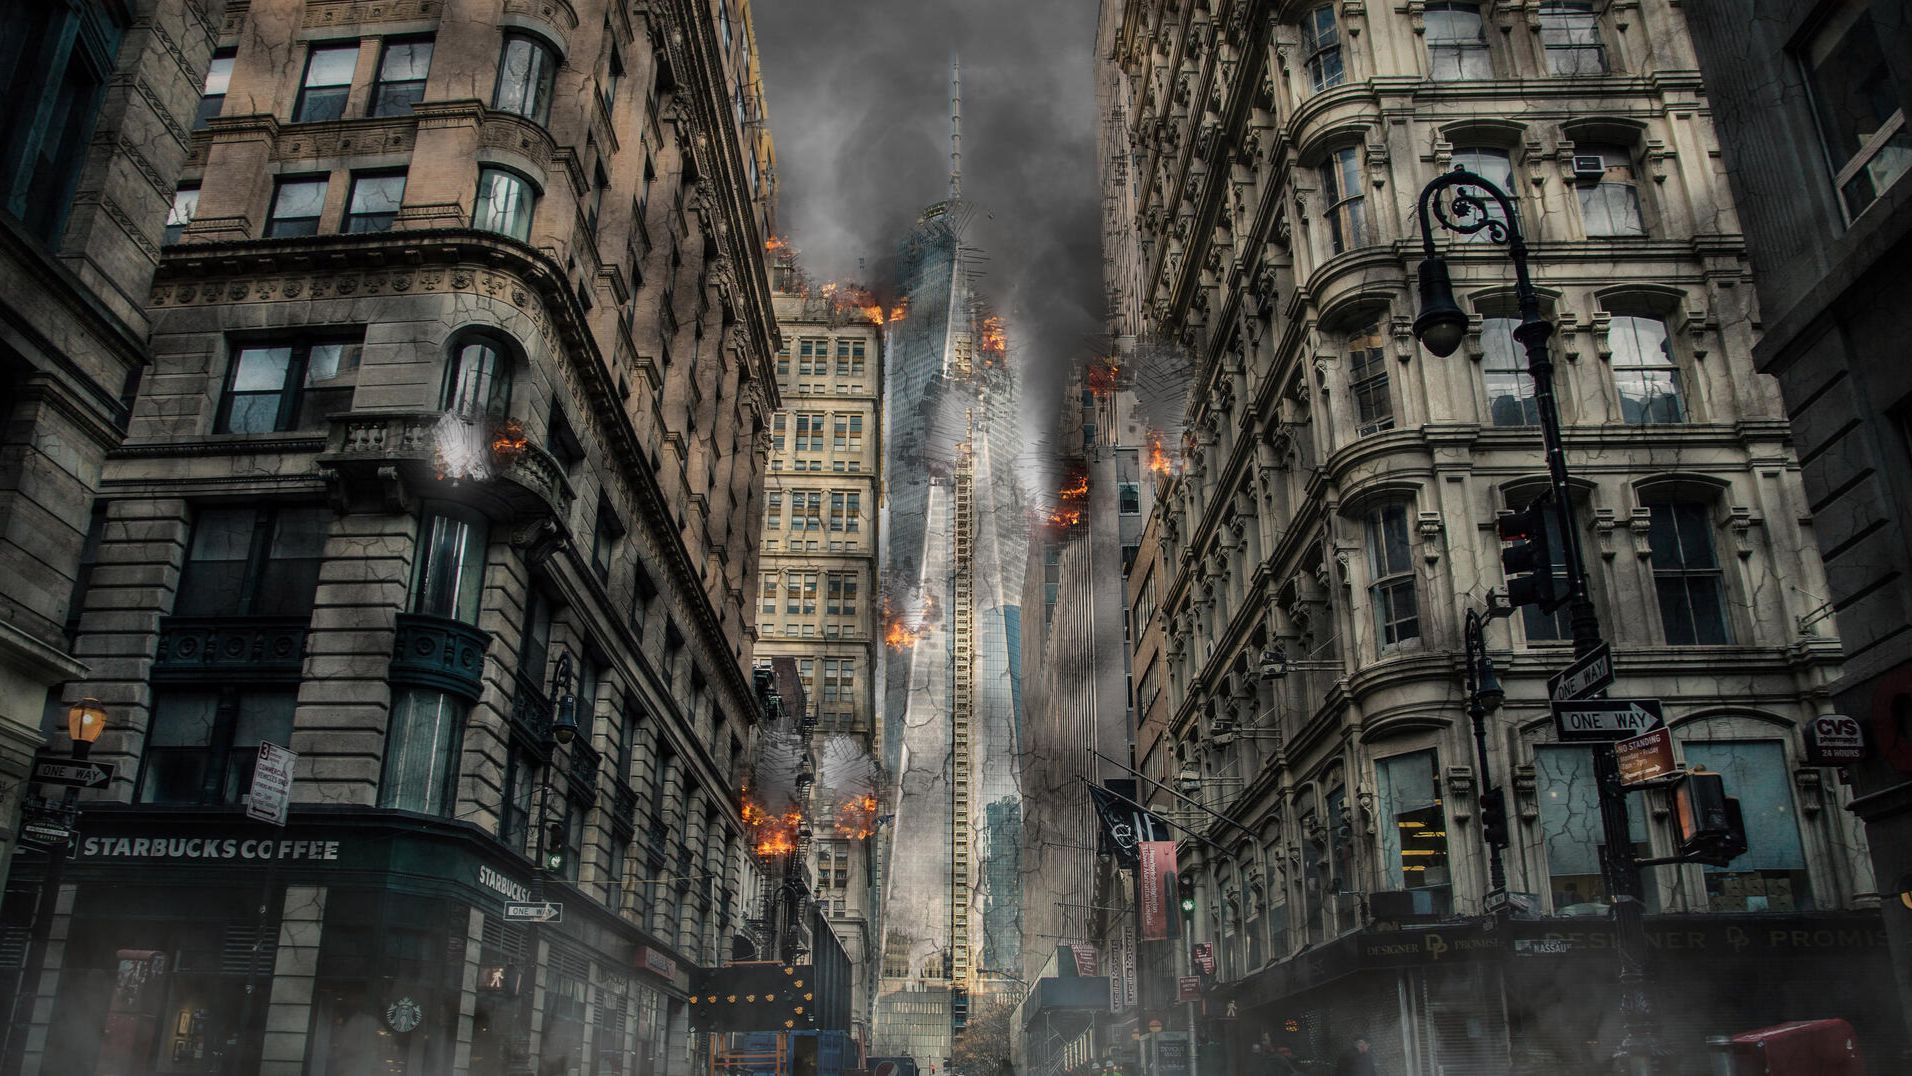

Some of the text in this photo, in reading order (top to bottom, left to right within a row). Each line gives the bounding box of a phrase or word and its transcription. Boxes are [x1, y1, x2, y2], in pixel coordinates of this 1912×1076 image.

[1558, 663, 1605, 700] ONE WAY
[1570, 712, 1648, 729] ONE WAY
[1817, 719, 1857, 736] CVS
[261, 744, 269, 759] 3
[1617, 734, 1661, 754] NO STANDING
[1821, 749, 1860, 758] 24 HOURS
[42, 765, 100, 781] ONE WAY
[257, 770, 278, 783] VEHICLES
[258, 762, 288, 779] COMMERCIAL
[83, 836, 340, 860] STARBUCKS COFFEE
[479, 864, 527, 903] STARBUCKS
[512, 907, 553, 915] ONE WAY
[1544, 929, 1890, 950] DESINER PROMIS
[1367, 943, 1420, 956] DESIGNER
[1534, 944, 1566, 953] NASSAU
[1125, 927, 1134, 1004] Lucille Roberts
